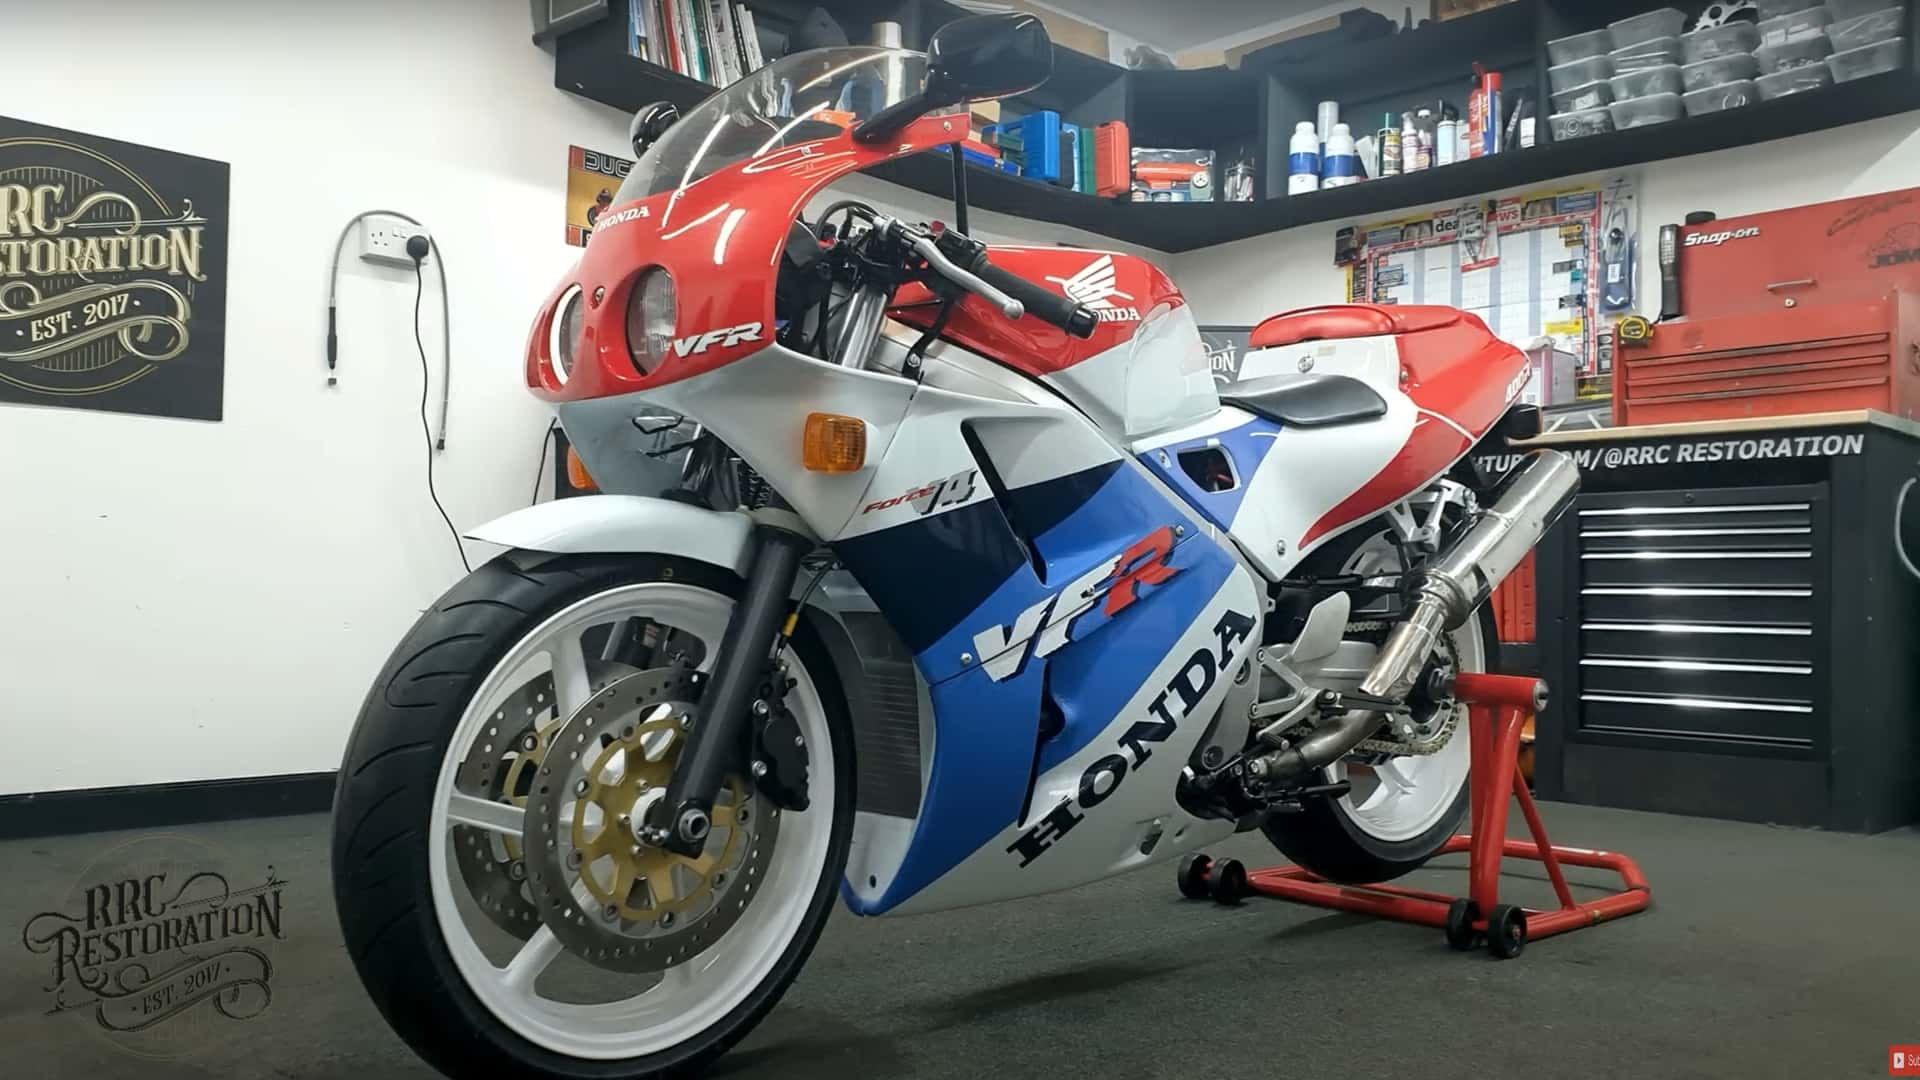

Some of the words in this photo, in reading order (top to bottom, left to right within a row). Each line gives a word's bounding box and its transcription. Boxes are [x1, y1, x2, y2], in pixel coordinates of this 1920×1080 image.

[584, 150, 637, 178] DUC
[595, 205, 650, 232] HONDA
[1684, 226, 1760, 247] Snap-on
[0, 226, 208, 282] TORATION
[31, 311, 77, 342] EST.
[83, 293, 129, 327] 2017
[1096, 306, 1142, 322] NDA
[672, 321, 764, 358] VFR
[1677, 434, 1864, 463] RESTORATION
[973, 525, 1189, 682] VFR
[1006, 609, 1257, 868] HONDA
